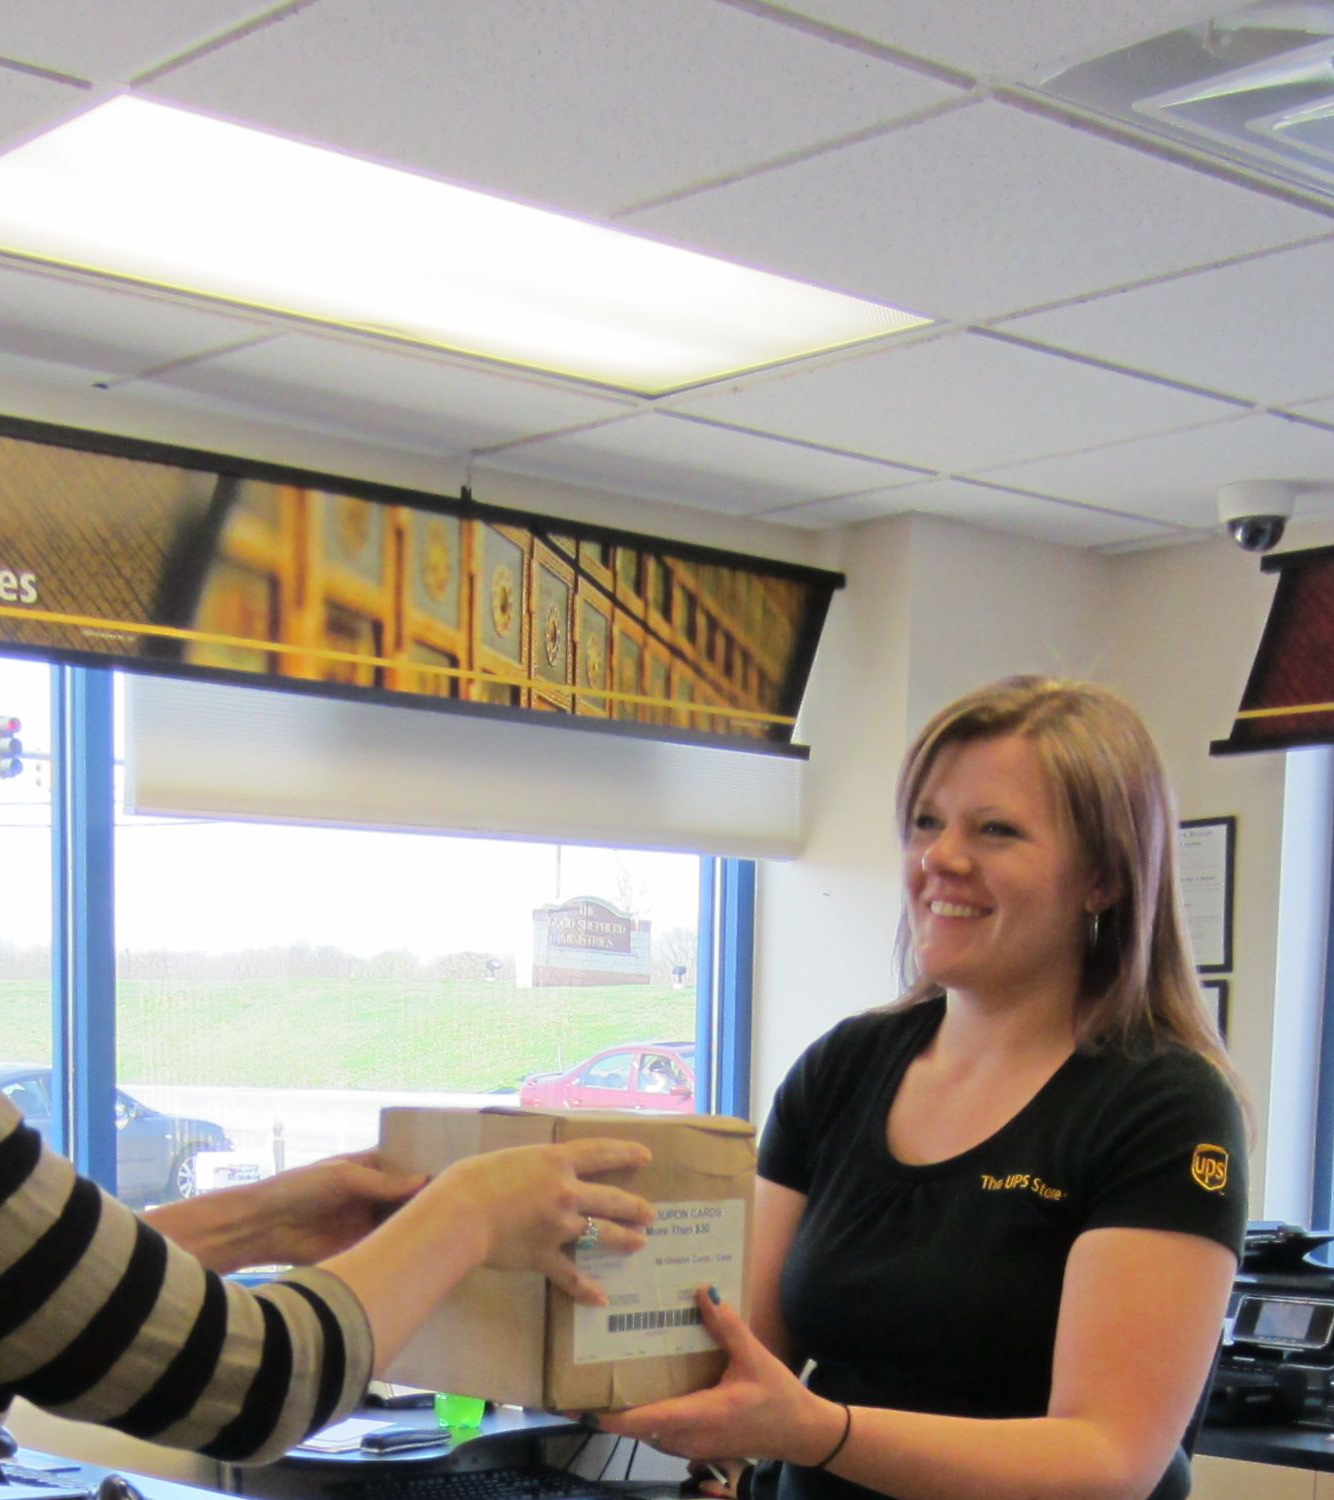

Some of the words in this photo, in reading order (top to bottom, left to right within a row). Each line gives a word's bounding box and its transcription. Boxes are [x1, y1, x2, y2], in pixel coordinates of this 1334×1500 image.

[1195, 1154, 1226, 1184] ups
[981, 1175, 1003, 1190] The
[1005, 1174, 1031, 1189] UPS
[1031, 1178, 1062, 1201] Store
[691, 1207, 723, 1219] CARDS
[672, 1225, 693, 1236] Than
